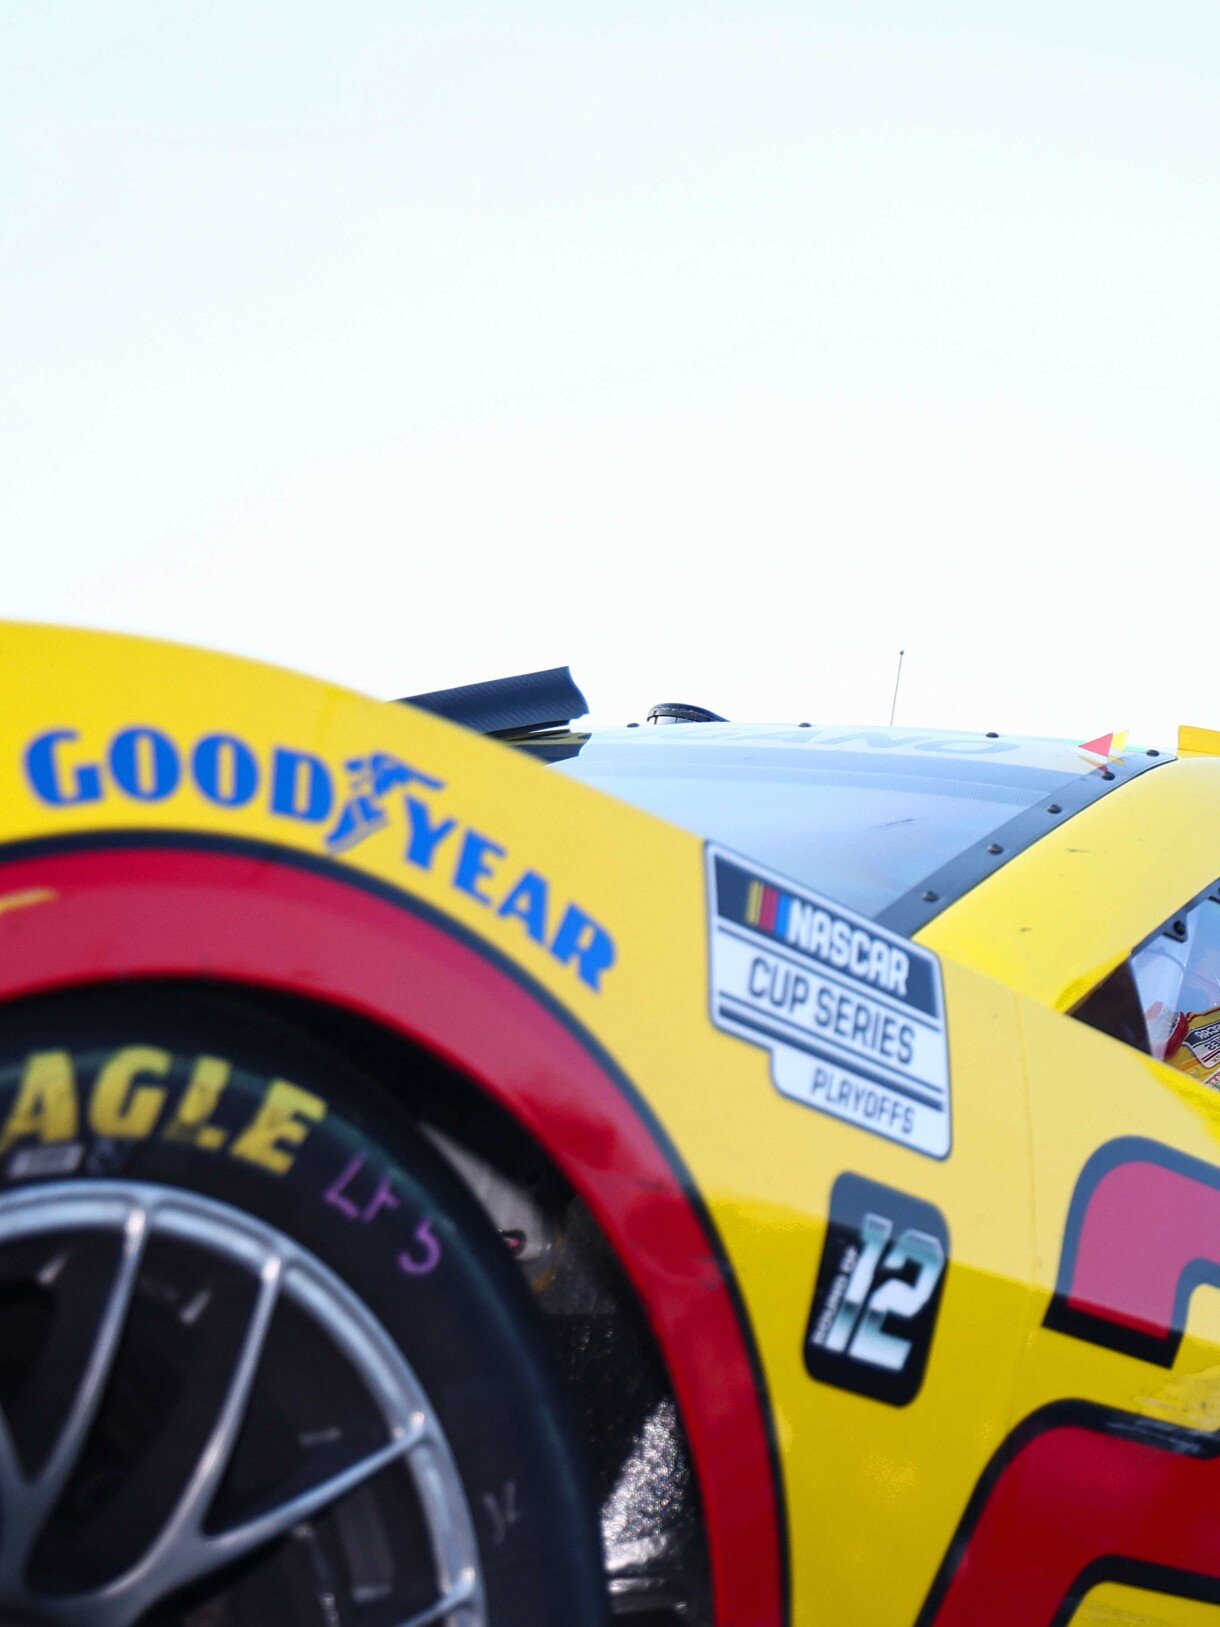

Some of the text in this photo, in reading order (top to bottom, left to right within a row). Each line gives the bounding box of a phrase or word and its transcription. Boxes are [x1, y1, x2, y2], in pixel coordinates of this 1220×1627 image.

[24, 725, 616, 993] GOODYEAR
[788, 898, 909, 997] NASCAR
[749, 956, 915, 1066] CUP SERIES
[812, 1067, 915, 1135] PLAYOFFS
[825, 1212, 945, 1372] 12
